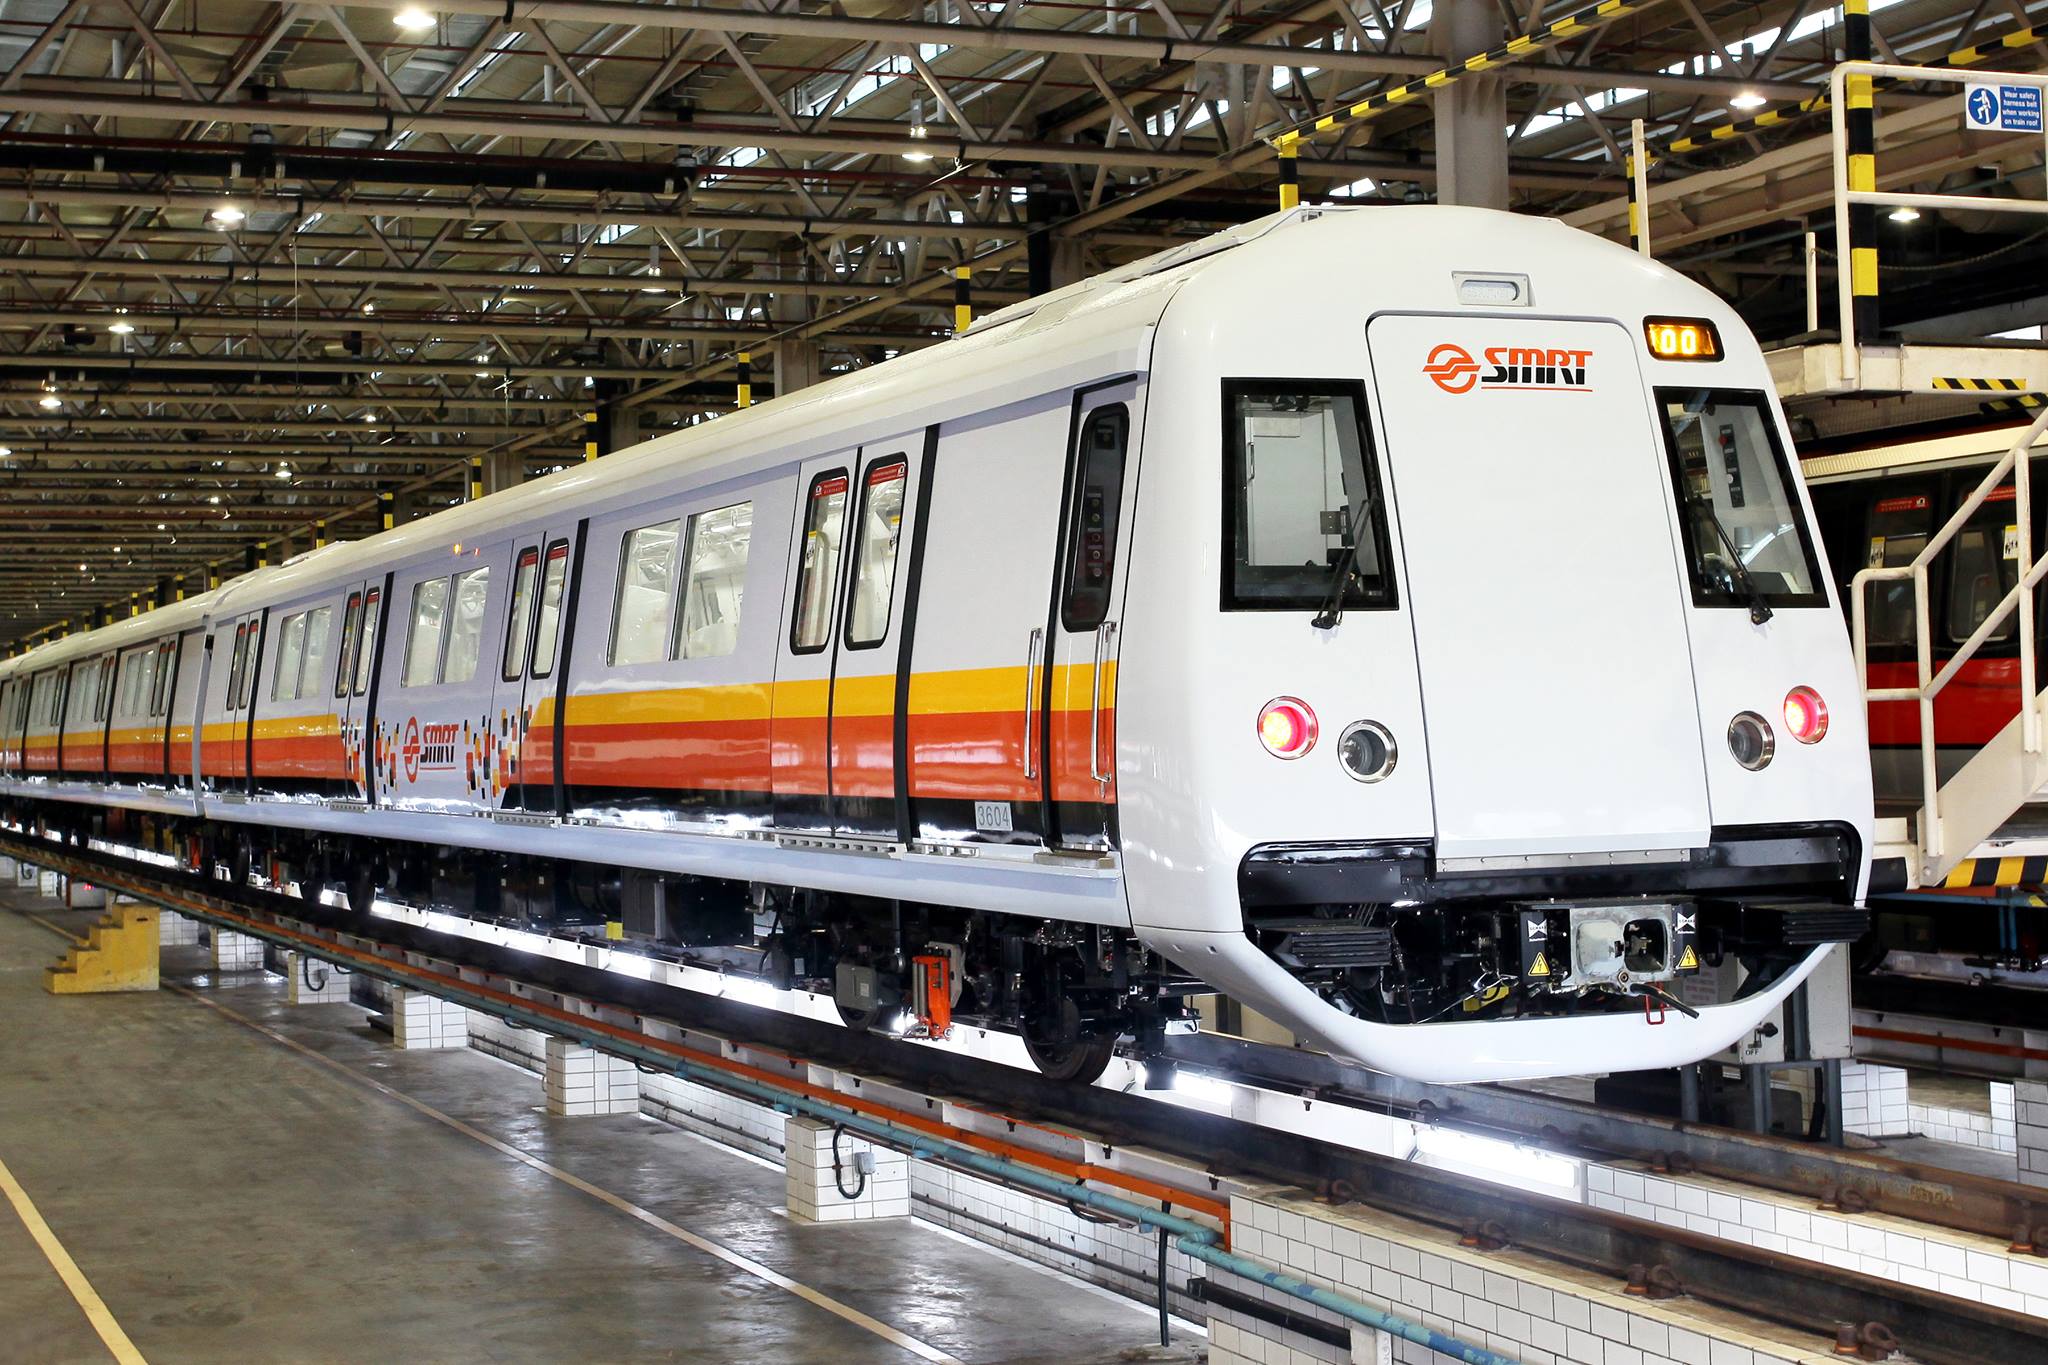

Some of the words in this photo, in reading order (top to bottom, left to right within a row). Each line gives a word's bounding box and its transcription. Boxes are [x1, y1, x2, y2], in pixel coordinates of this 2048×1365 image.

[2019, 91, 2036, 100] safety
[2027, 100, 2038, 108] belt
[2018, 110, 2040, 119] working
[1481, 347, 1593, 385] SMRT
[420, 723, 459, 763] SMRT
[977, 805, 1009, 827] 3604
